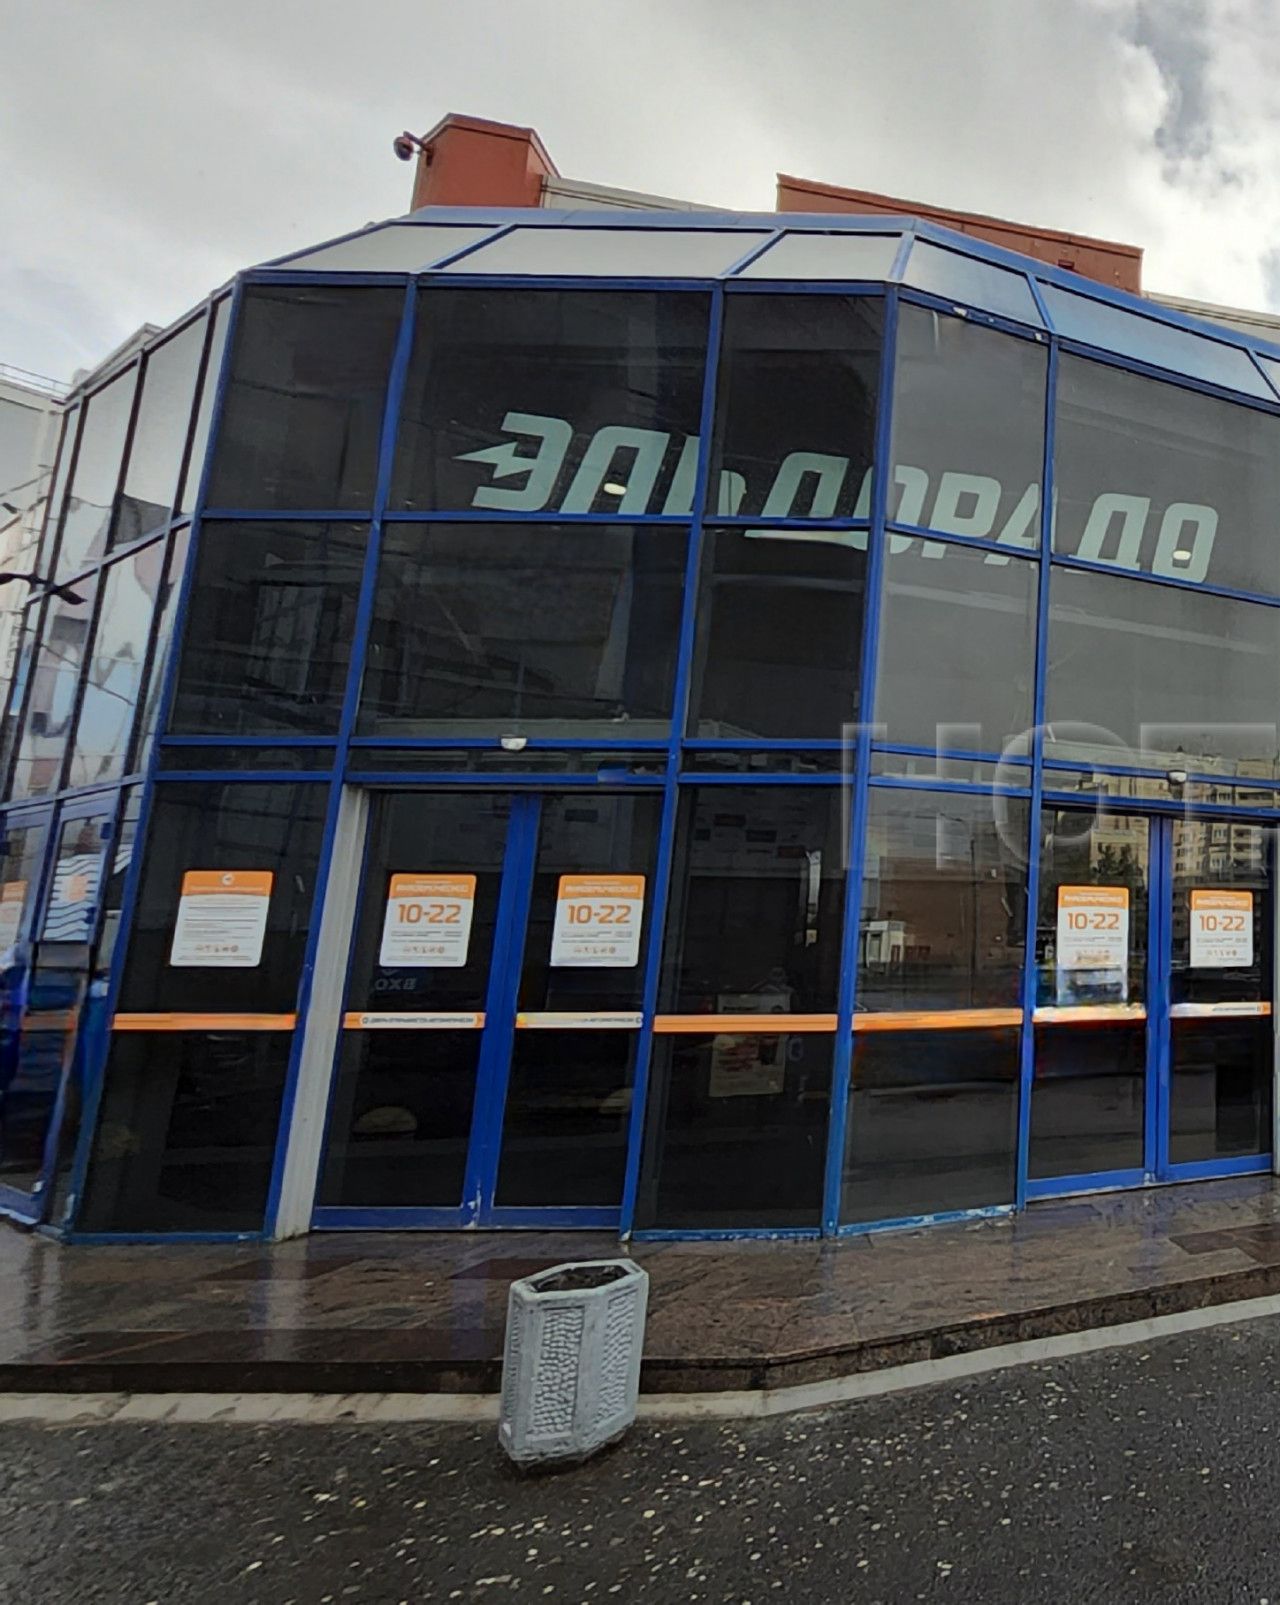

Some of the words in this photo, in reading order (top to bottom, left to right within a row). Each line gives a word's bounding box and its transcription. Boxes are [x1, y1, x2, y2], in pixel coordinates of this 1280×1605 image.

[397, 904, 462, 924] 10-22
[567, 904, 631, 924] 10-22
[1067, 912, 1120, 930] 10-22
[1199, 915, 1246, 931] 10-22
